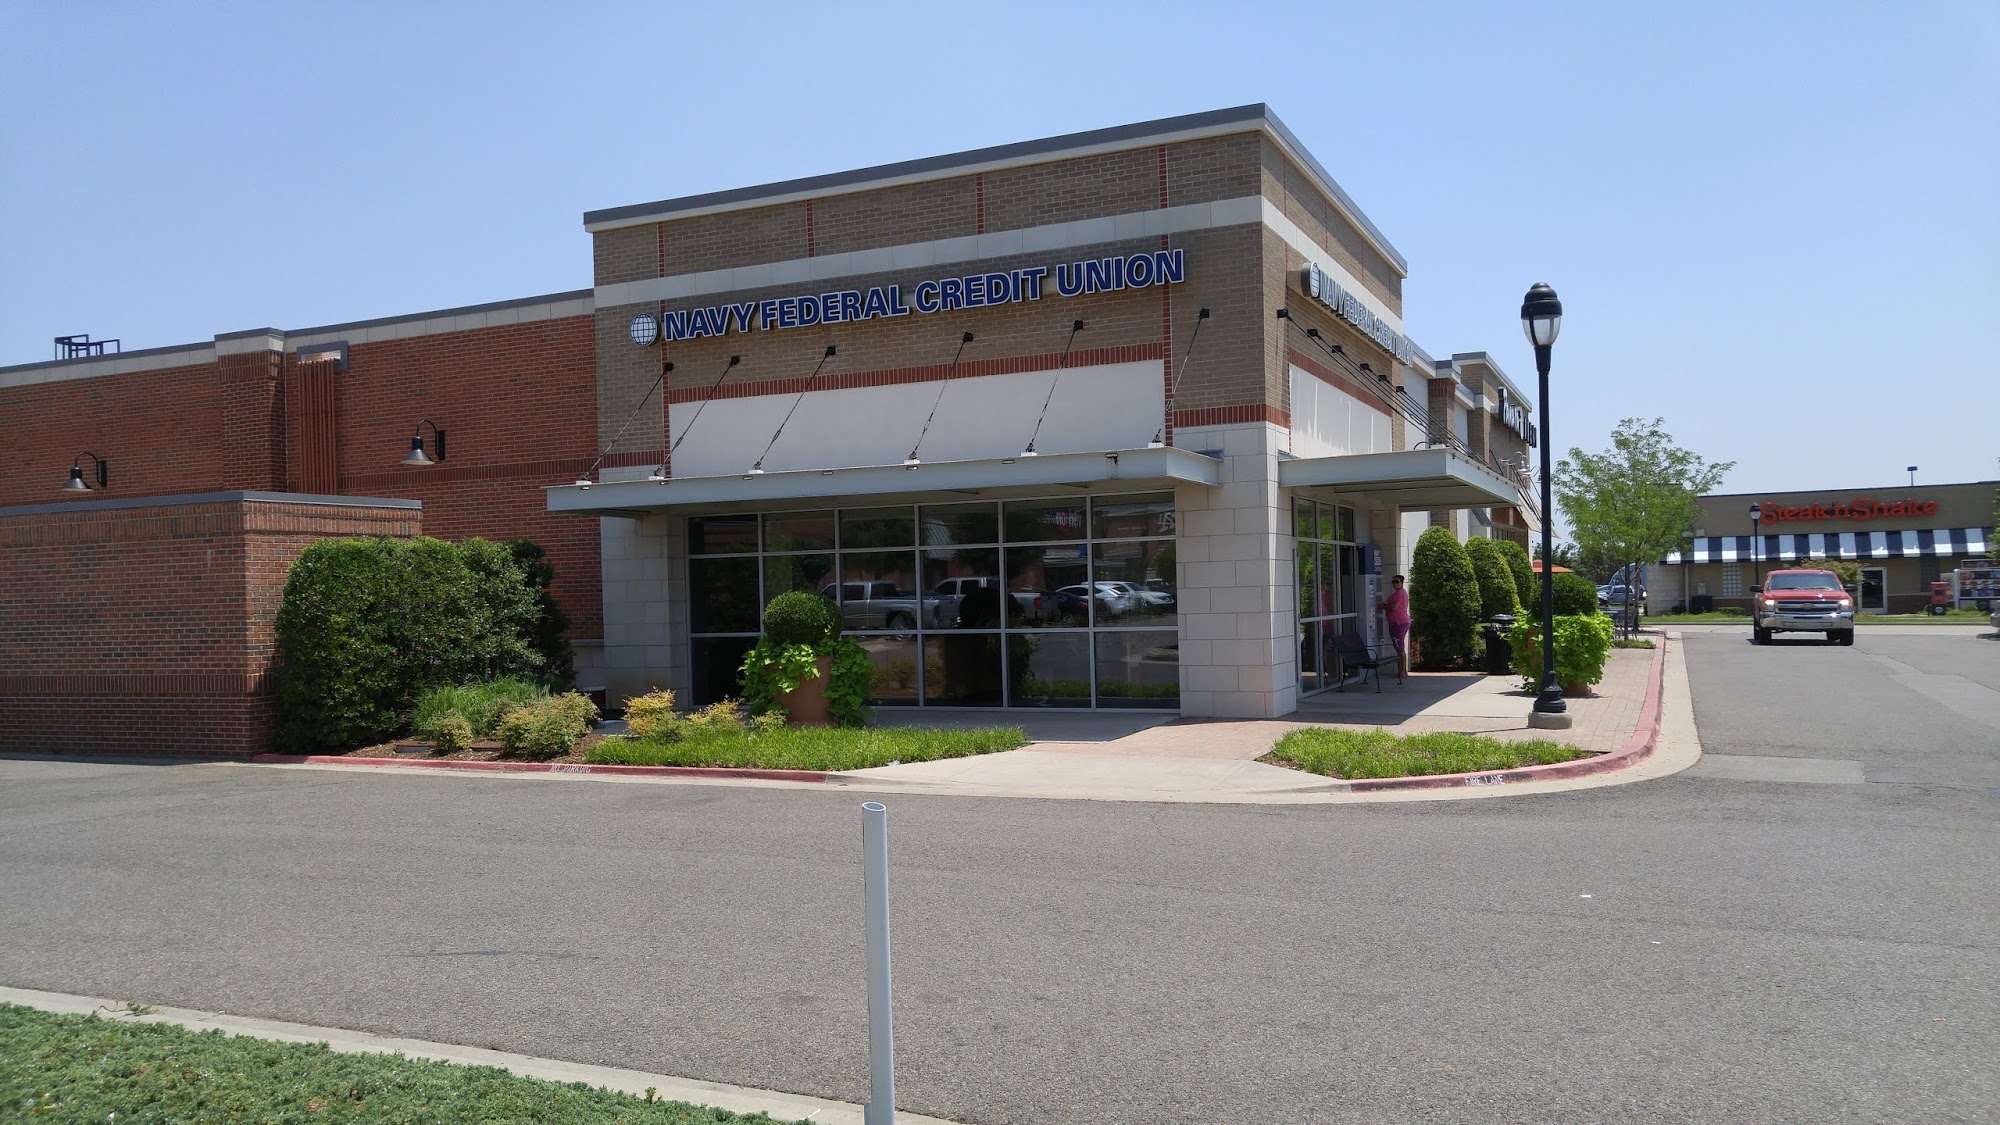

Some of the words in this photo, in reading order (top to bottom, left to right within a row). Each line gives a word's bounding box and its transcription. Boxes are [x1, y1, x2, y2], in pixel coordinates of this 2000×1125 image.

[664, 302, 756, 342] NAVY
[759, 285, 909, 331] FEDERAL
[914, 266, 1047, 314] CREDIT
[1056, 248, 1184, 297] UNION
[1320, 271, 1346, 316] NAVY
[1343, 290, 1376, 339] FEDERAL
[1851, 498, 1939, 521] Shake
[563, 764, 592, 774] PARKING
[1464, 776, 1482, 786] FIRE
[1484, 774, 1506, 785] LANE
